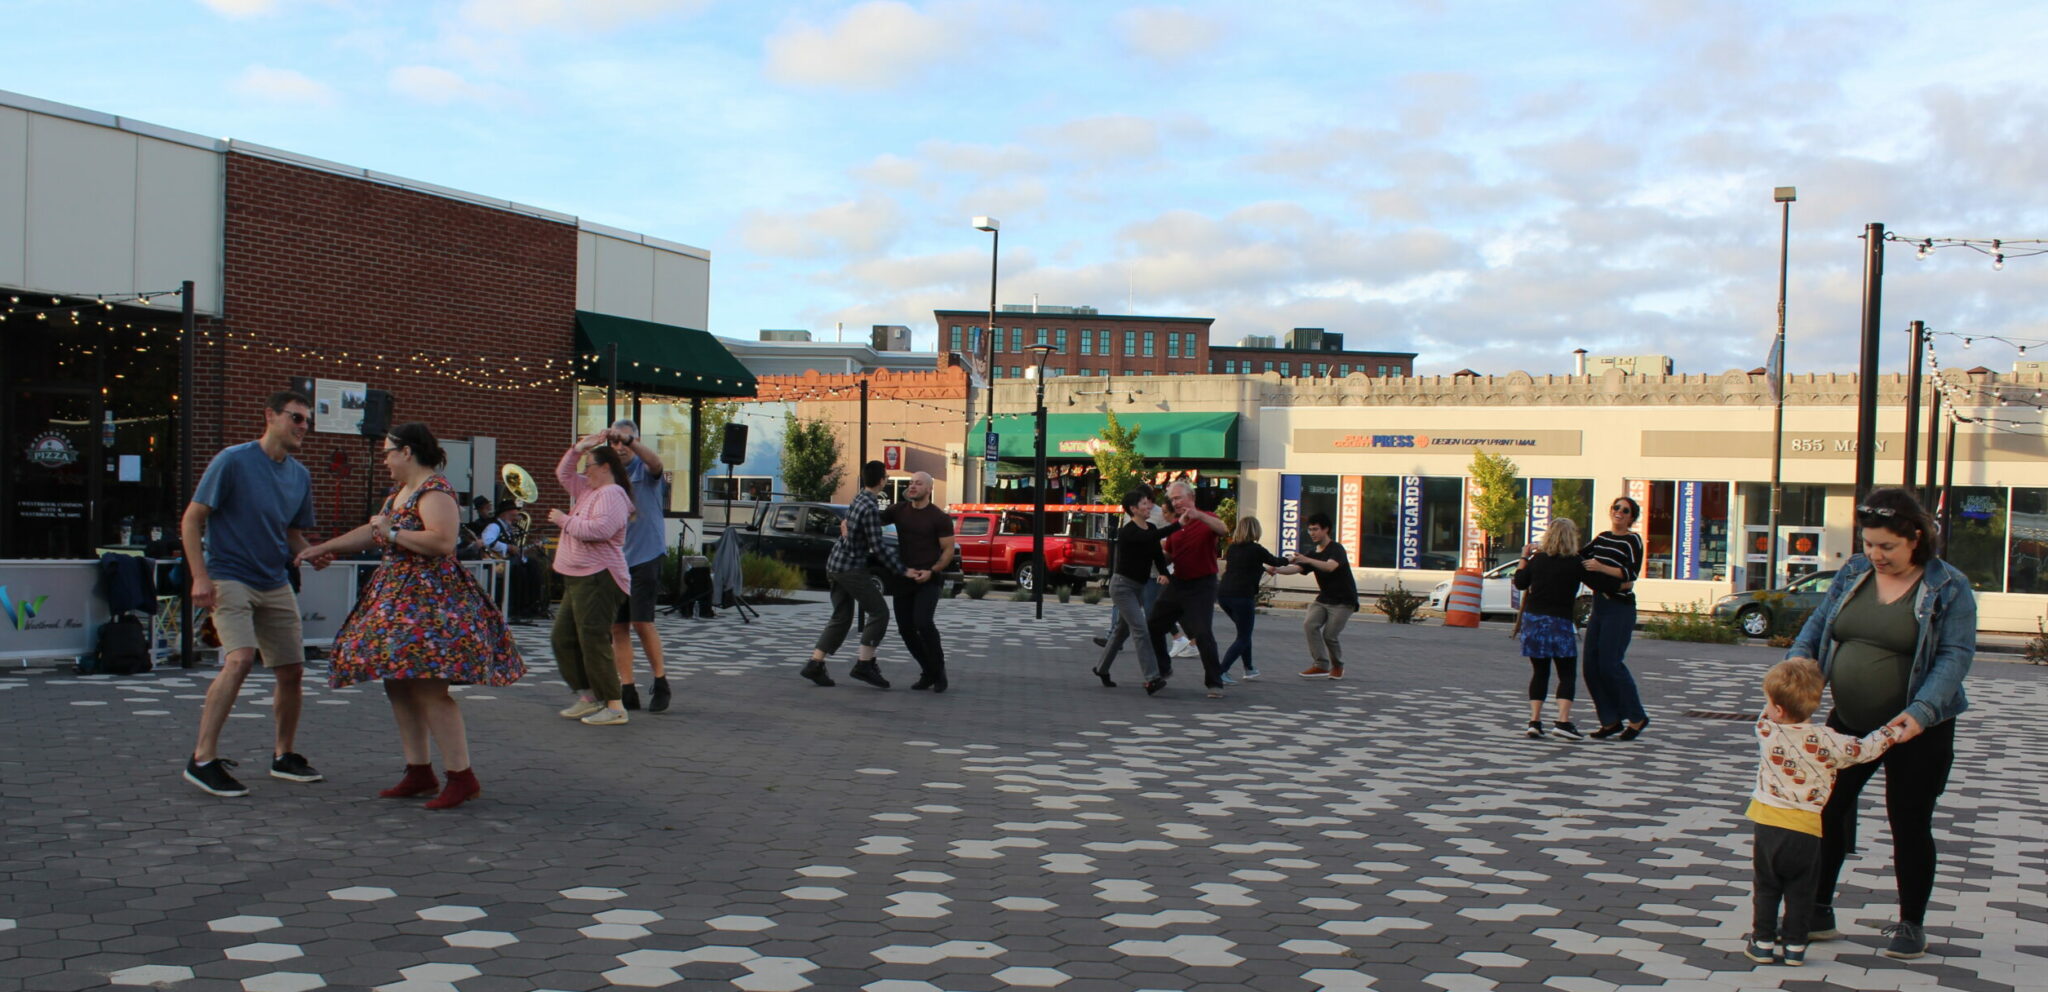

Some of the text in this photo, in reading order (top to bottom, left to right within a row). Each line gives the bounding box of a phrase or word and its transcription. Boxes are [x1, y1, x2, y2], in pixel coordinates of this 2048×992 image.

[34, 451, 70, 461] PIZZA
[1372, 435, 1415, 448] PRESS
[1431, 438, 1460, 446] DESIGN
[1792, 439, 1887, 452] 855 MAN
[1342, 483, 1358, 564] BANNERS
[1403, 476, 1419, 567] POSTCARDS
[1531, 495, 1549, 545] NAGE
[1682, 482, 1695, 579] www.fullcourtpress.biz
